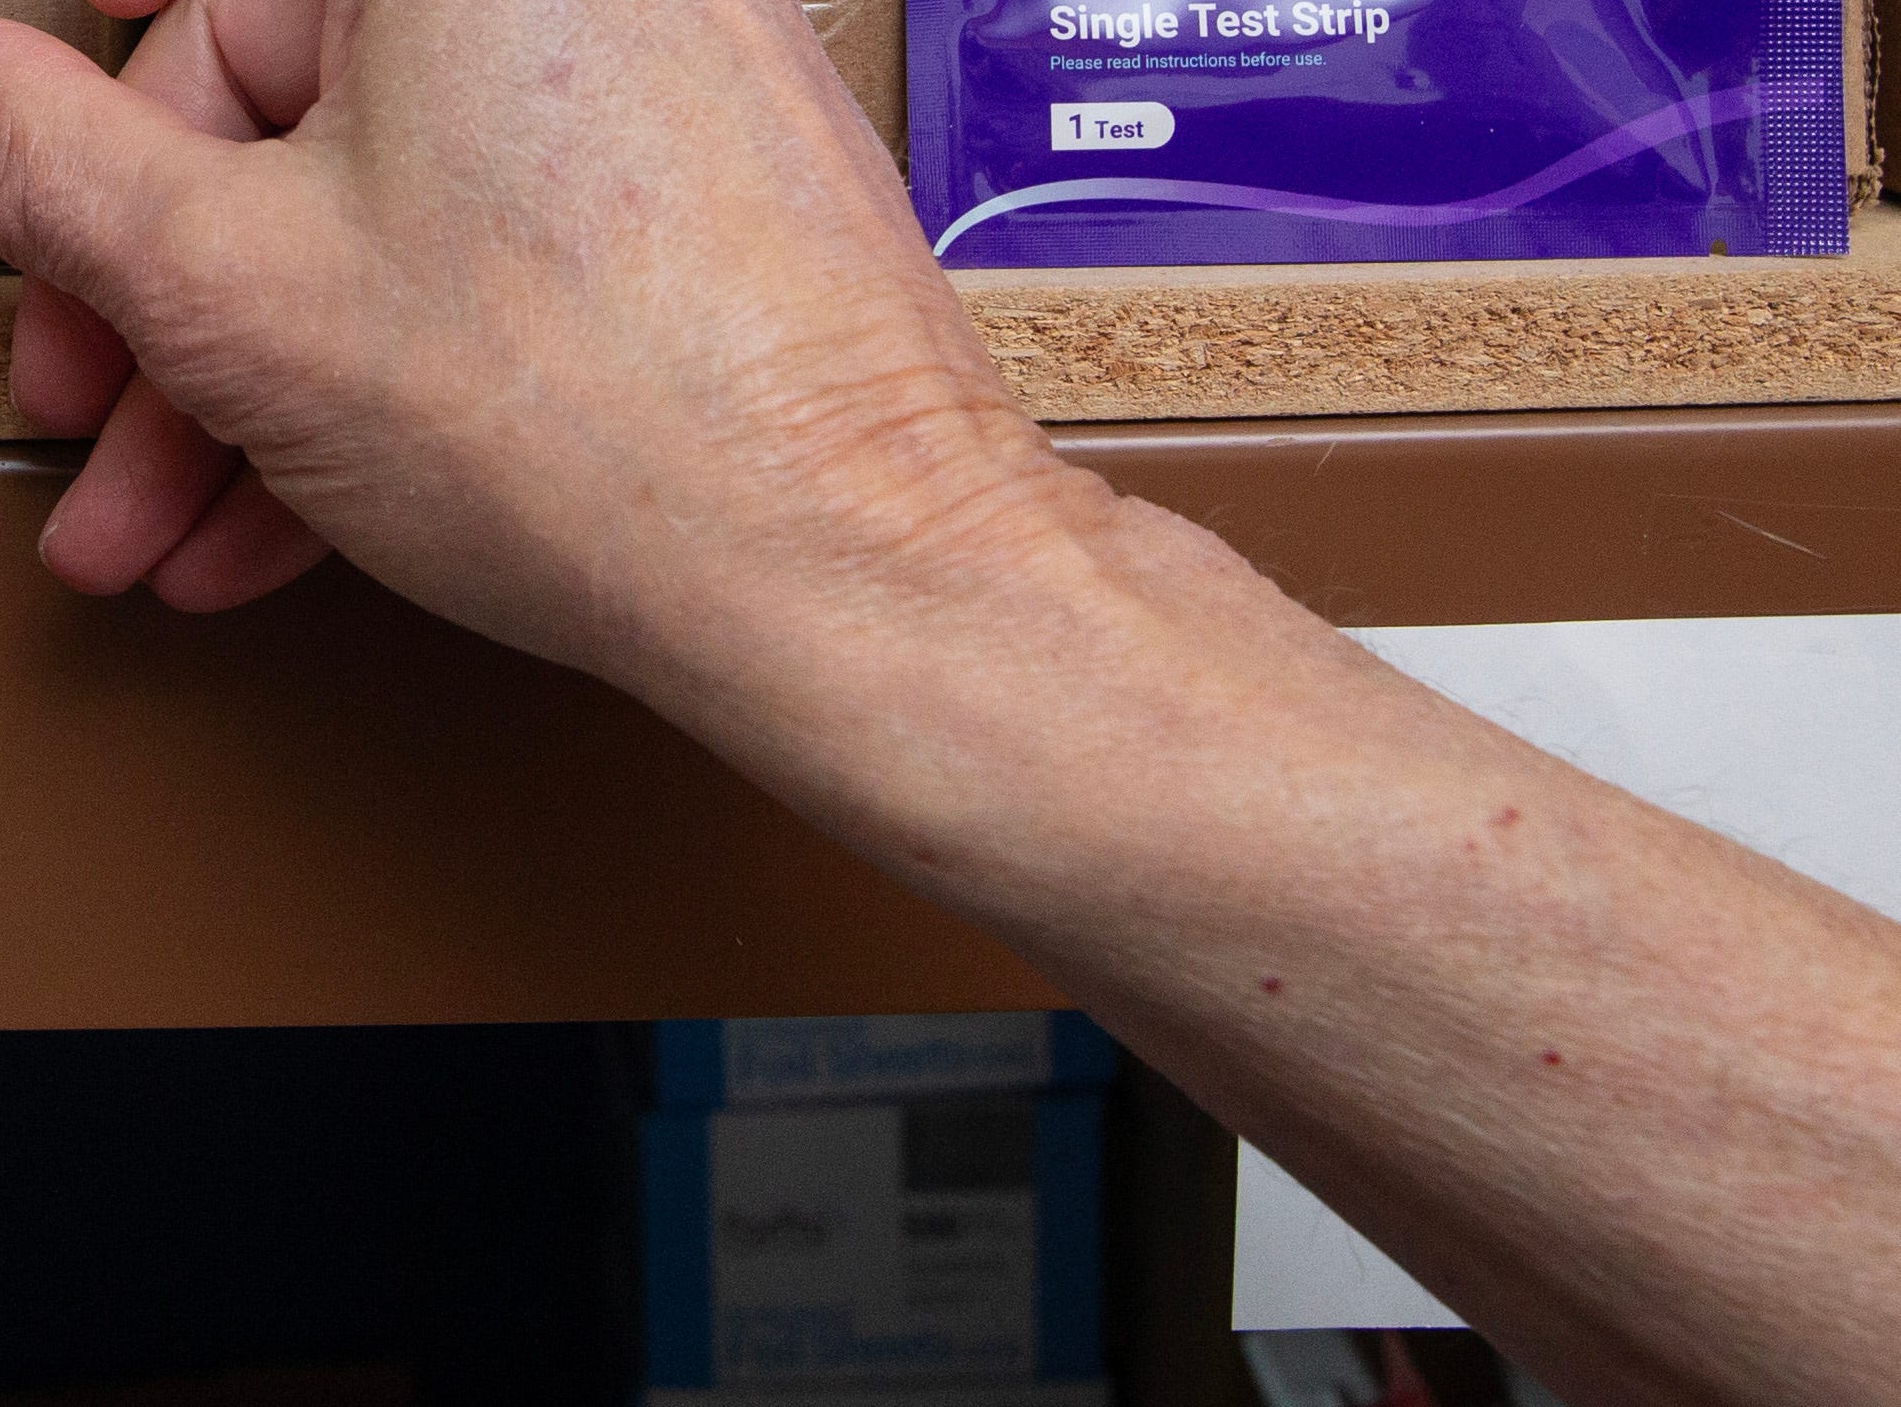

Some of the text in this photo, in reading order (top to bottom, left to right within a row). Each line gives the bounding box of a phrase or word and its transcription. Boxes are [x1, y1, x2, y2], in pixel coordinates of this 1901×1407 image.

[1049, 0, 1391, 48] Single Test Strip
[1050, 52, 1327, 70] Please read instructions before use.
[1068, 113, 1145, 140] 1 Test
